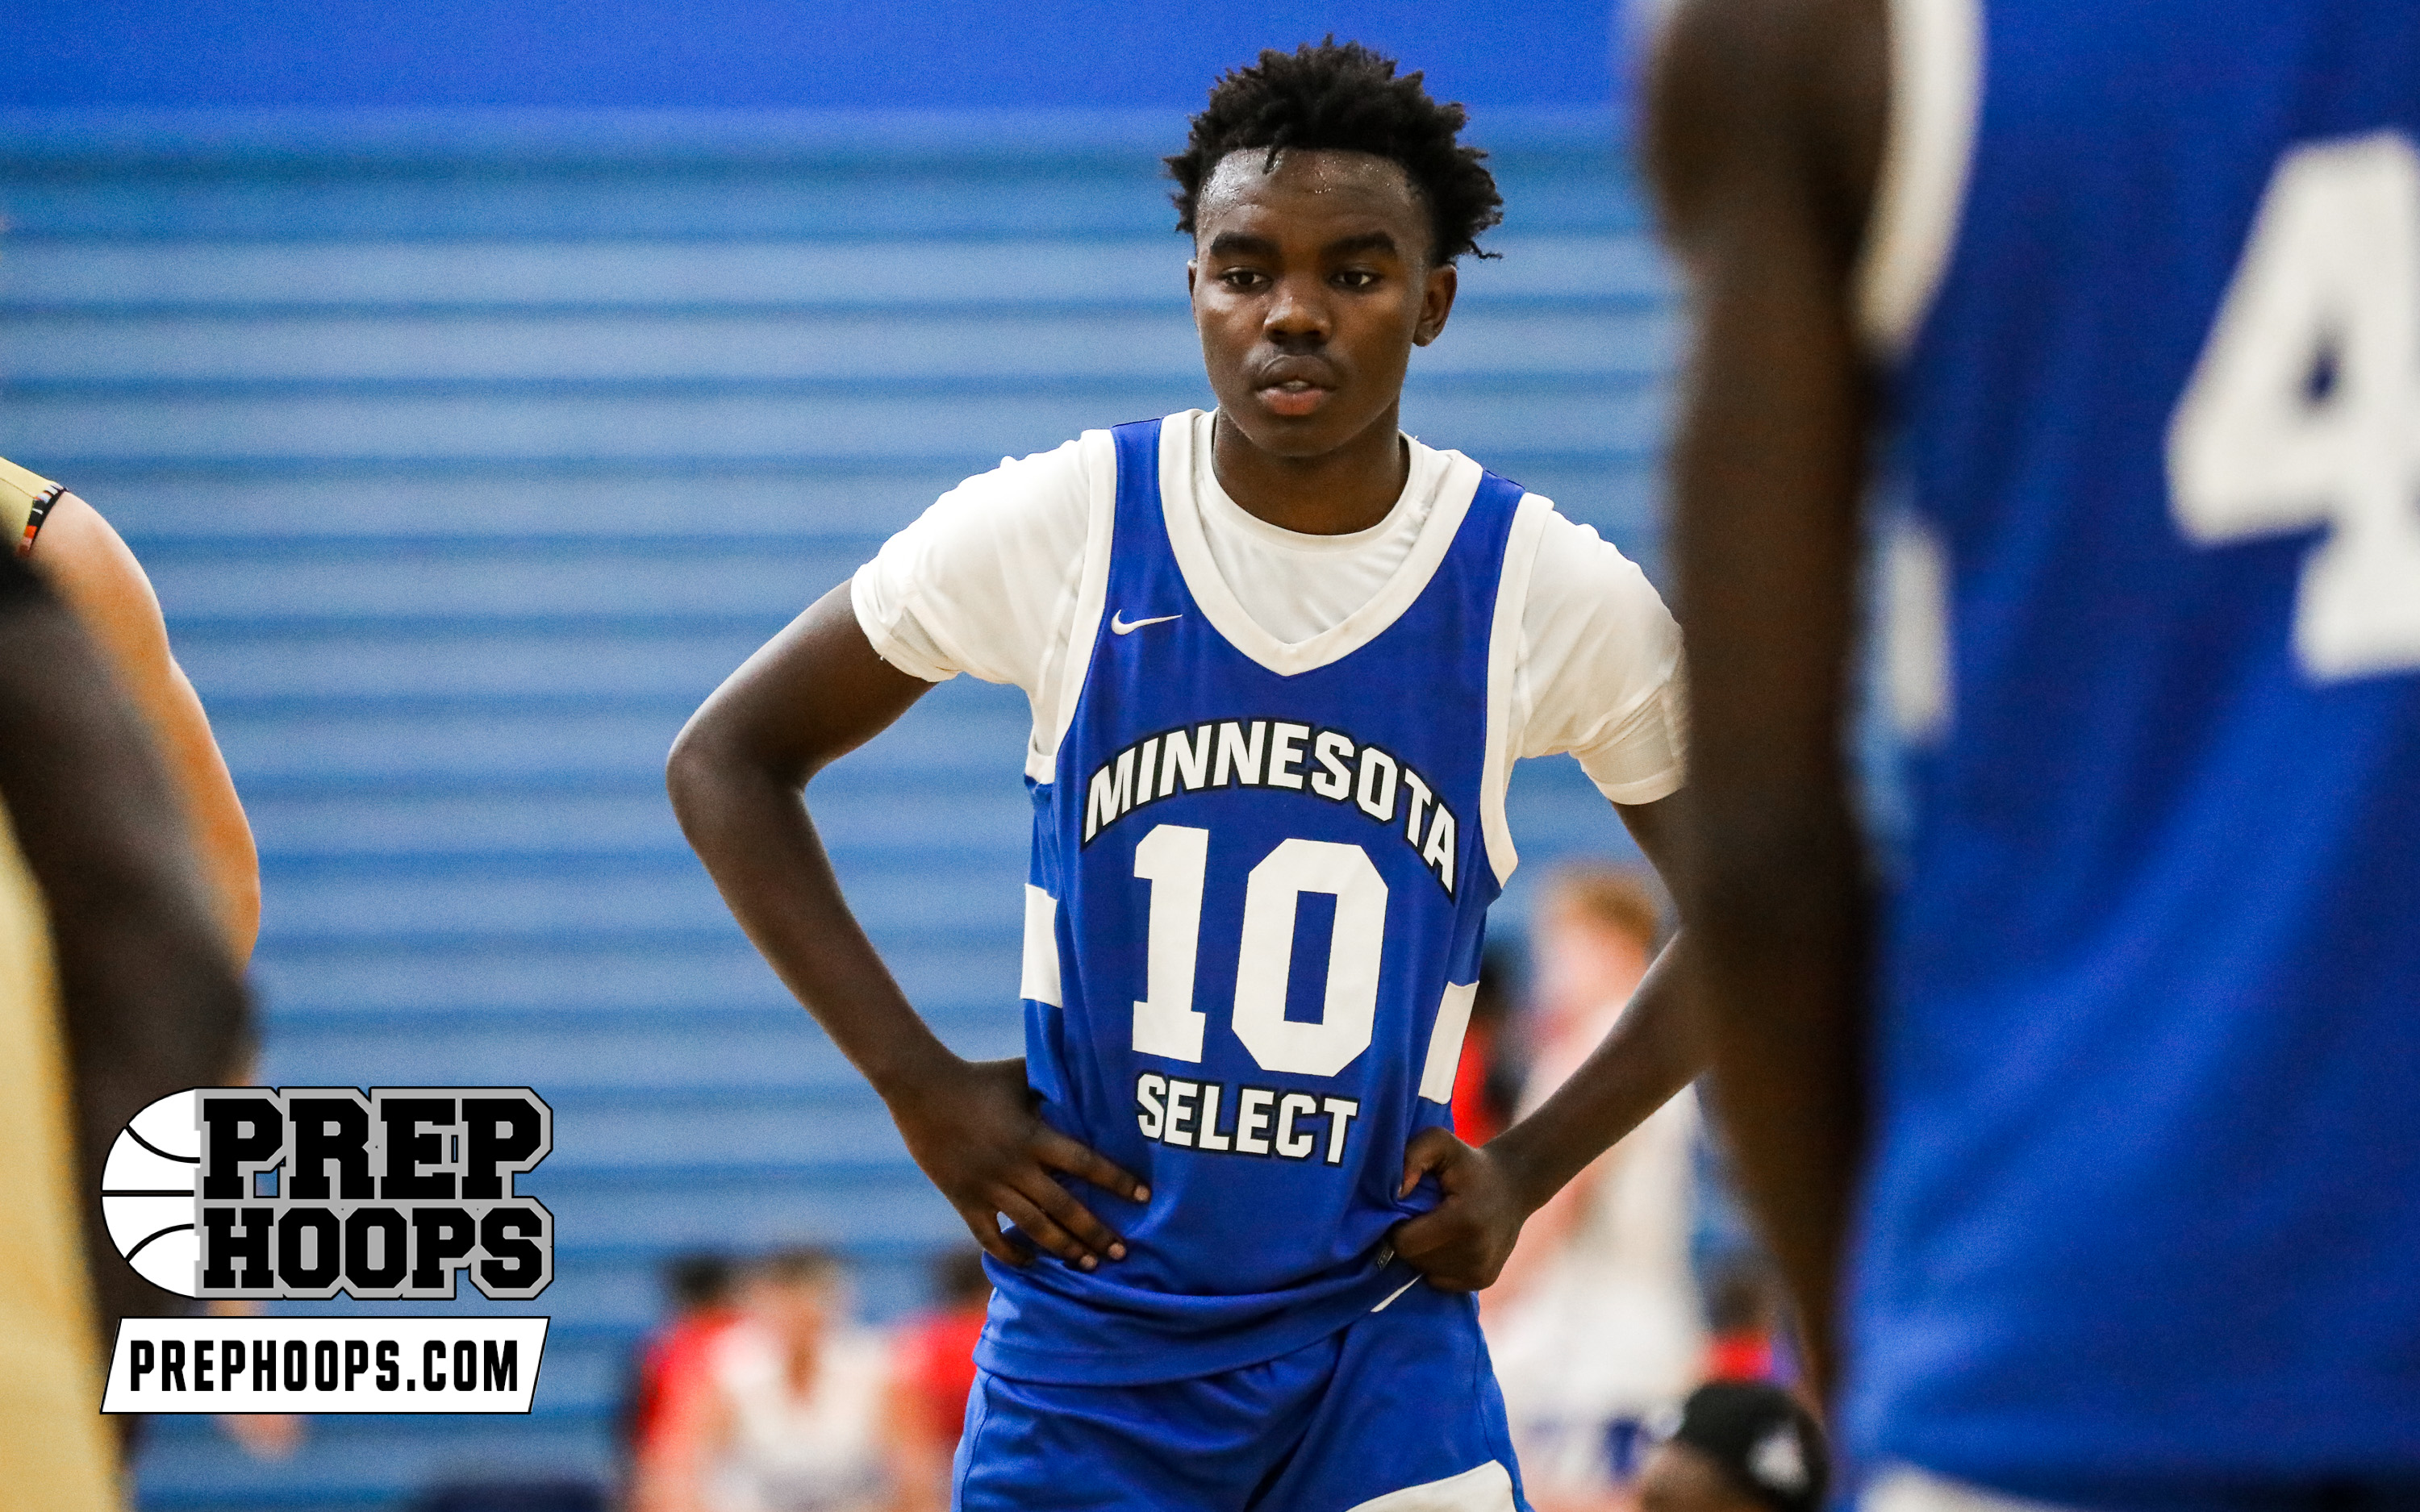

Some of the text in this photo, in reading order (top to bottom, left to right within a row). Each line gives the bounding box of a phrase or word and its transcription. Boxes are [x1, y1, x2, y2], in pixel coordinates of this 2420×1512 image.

[2167, 131, 2420, 682] 4
[1083, 719, 1457, 897] MINNESOTA
[1133, 823, 1389, 1078] 10
[1135, 1073, 1358, 1164] SELECT
